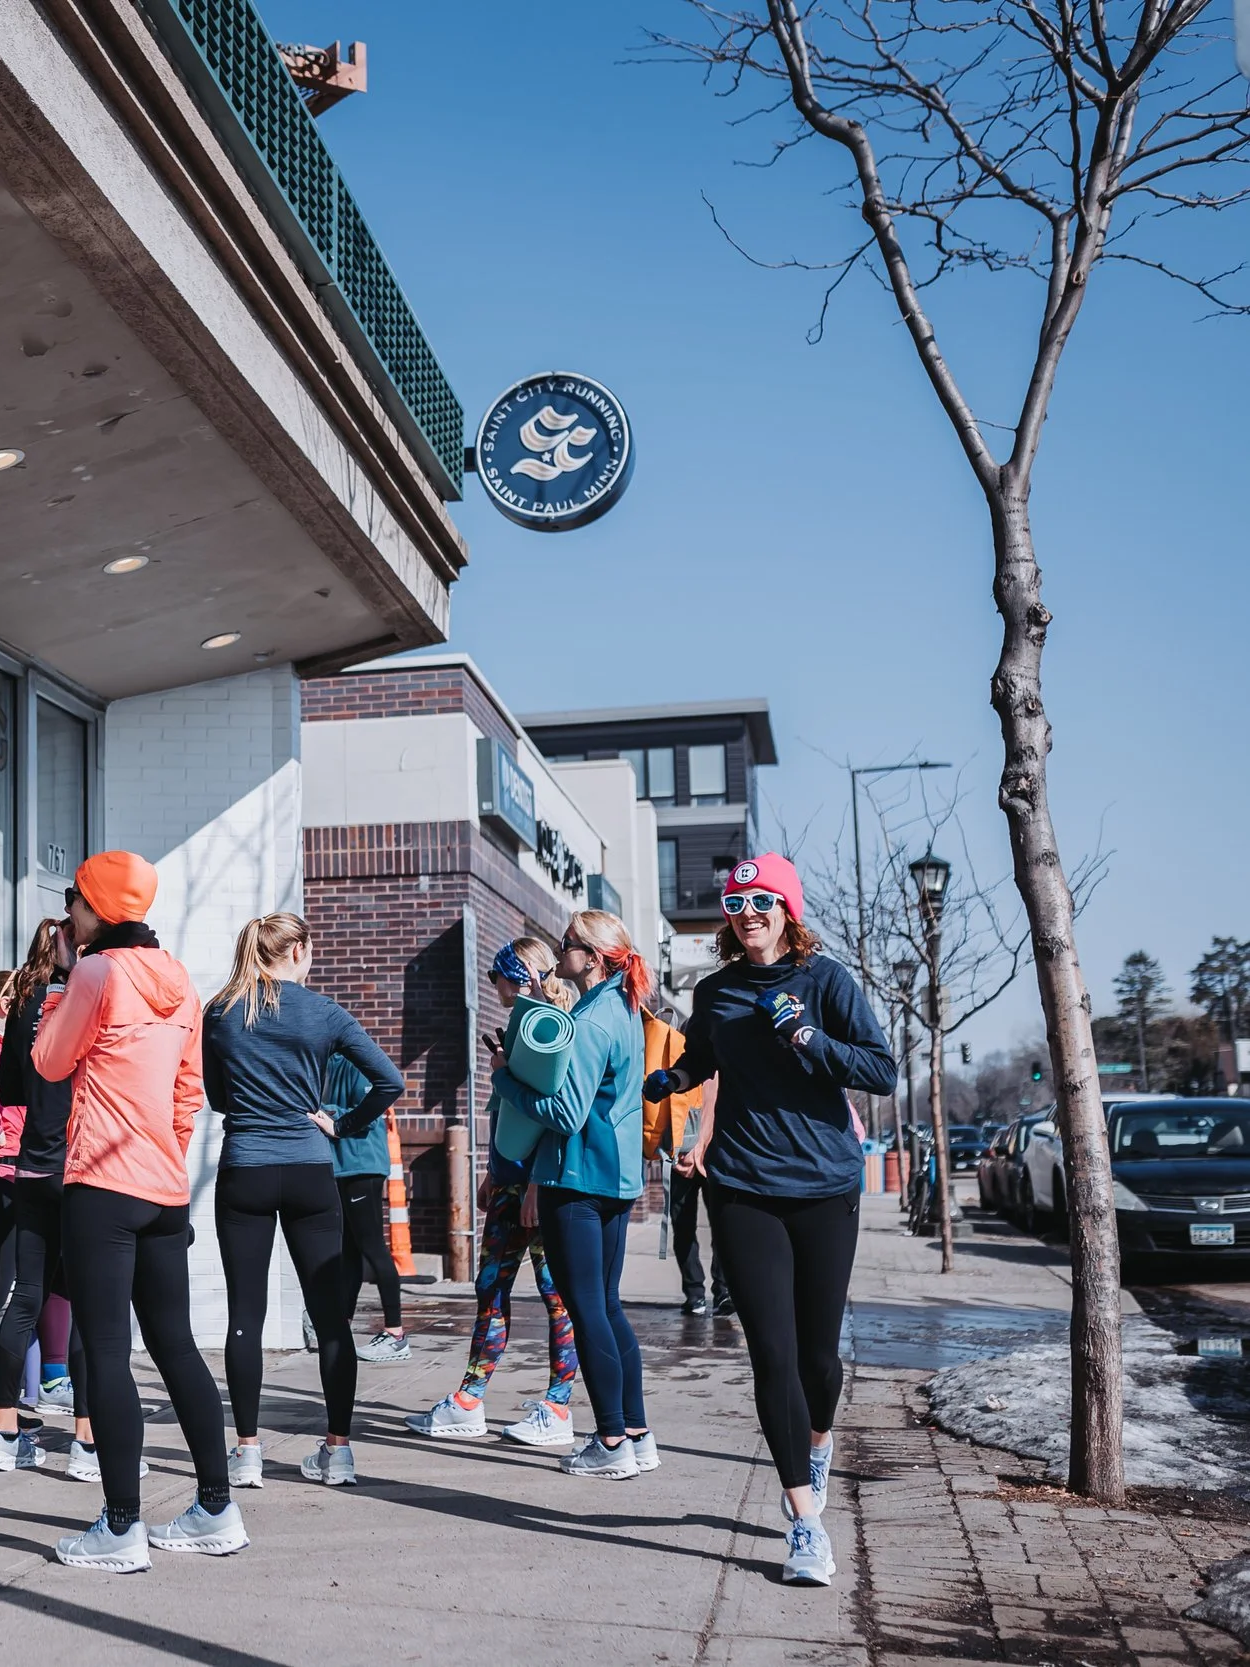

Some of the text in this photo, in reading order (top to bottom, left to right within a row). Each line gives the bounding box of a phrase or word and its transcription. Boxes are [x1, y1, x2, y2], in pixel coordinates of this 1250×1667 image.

[484, 380, 622, 452] SAINT CITY RUNNING
[486, 458, 620, 515] SAINT PAUL MINN
